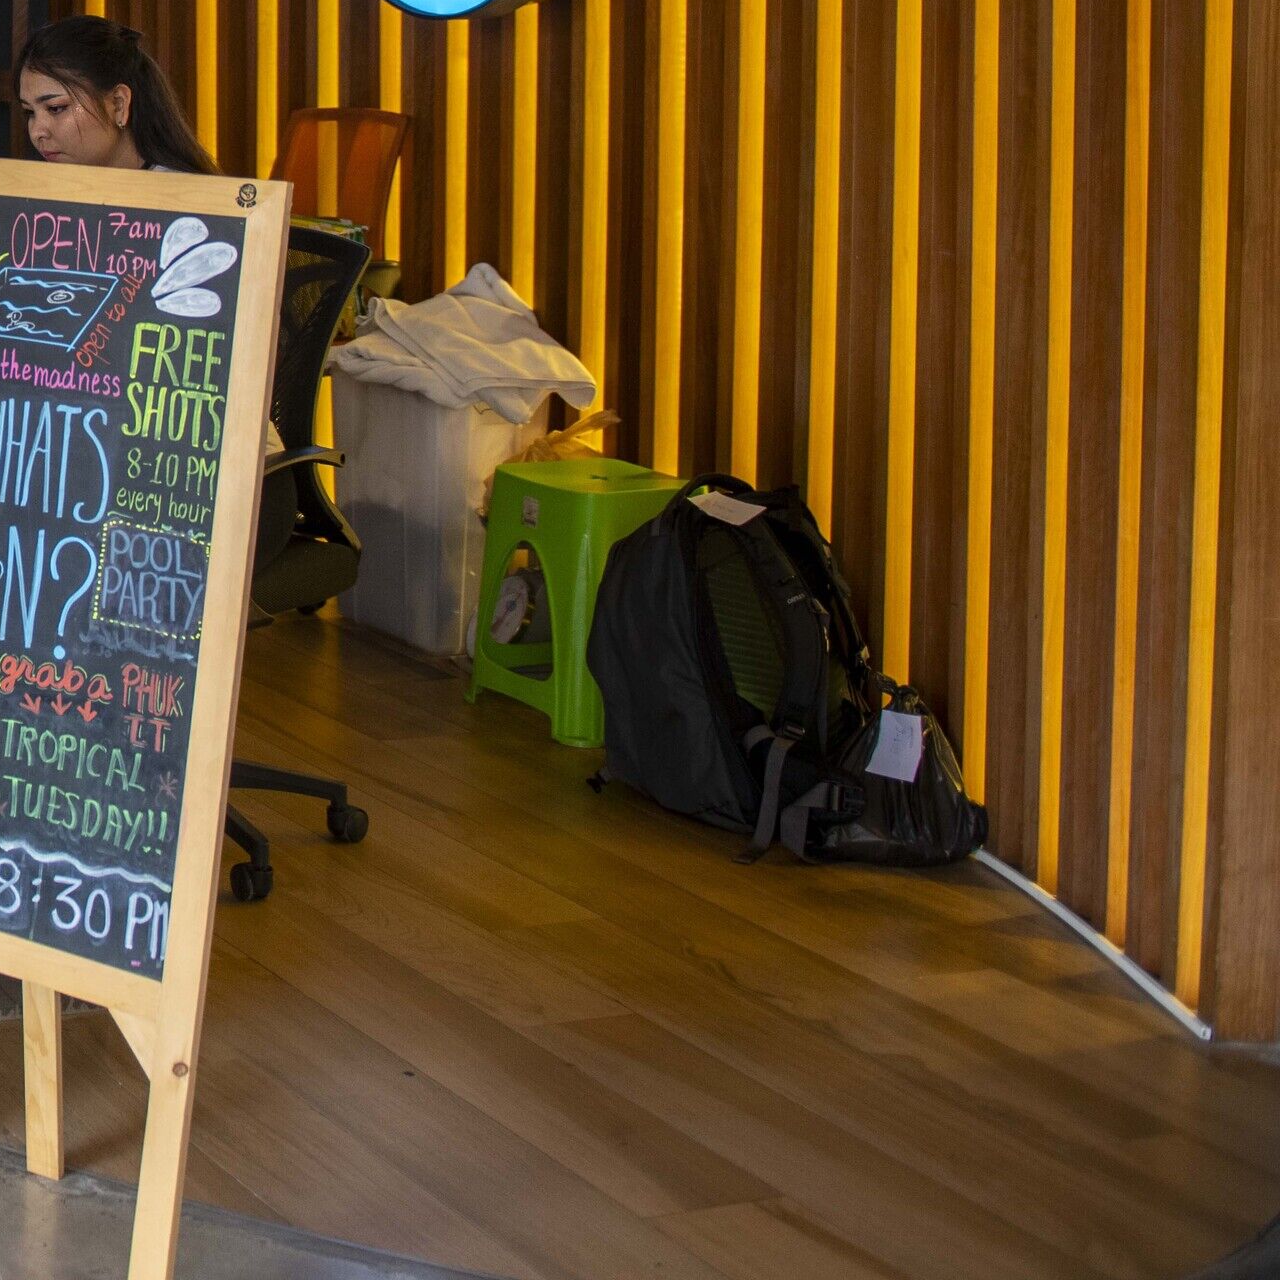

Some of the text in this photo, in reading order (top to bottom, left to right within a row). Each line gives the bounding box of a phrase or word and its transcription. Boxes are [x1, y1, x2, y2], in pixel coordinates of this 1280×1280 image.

[11, 212, 103, 273] OPEN
[108, 212, 162, 239] 7am
[75, 273, 146, 368] open to all
[129, 321, 225, 391] FREE
[121, 381, 226, 452] SHOTS
[116, 486, 212, 525] every hour
[186, 455, 218, 501] PM
[109, 528, 203, 580] POOL
[101, 565, 204, 631] PARTY
[87, 673, 113, 705] a
[120, 662, 185, 718] PHUK
[1, 718, 146, 793] TROPICAL
[123, 713, 172, 753] IT
[3, 775, 169, 855] TUESDAY!!
[124, 891, 170, 961] PM
